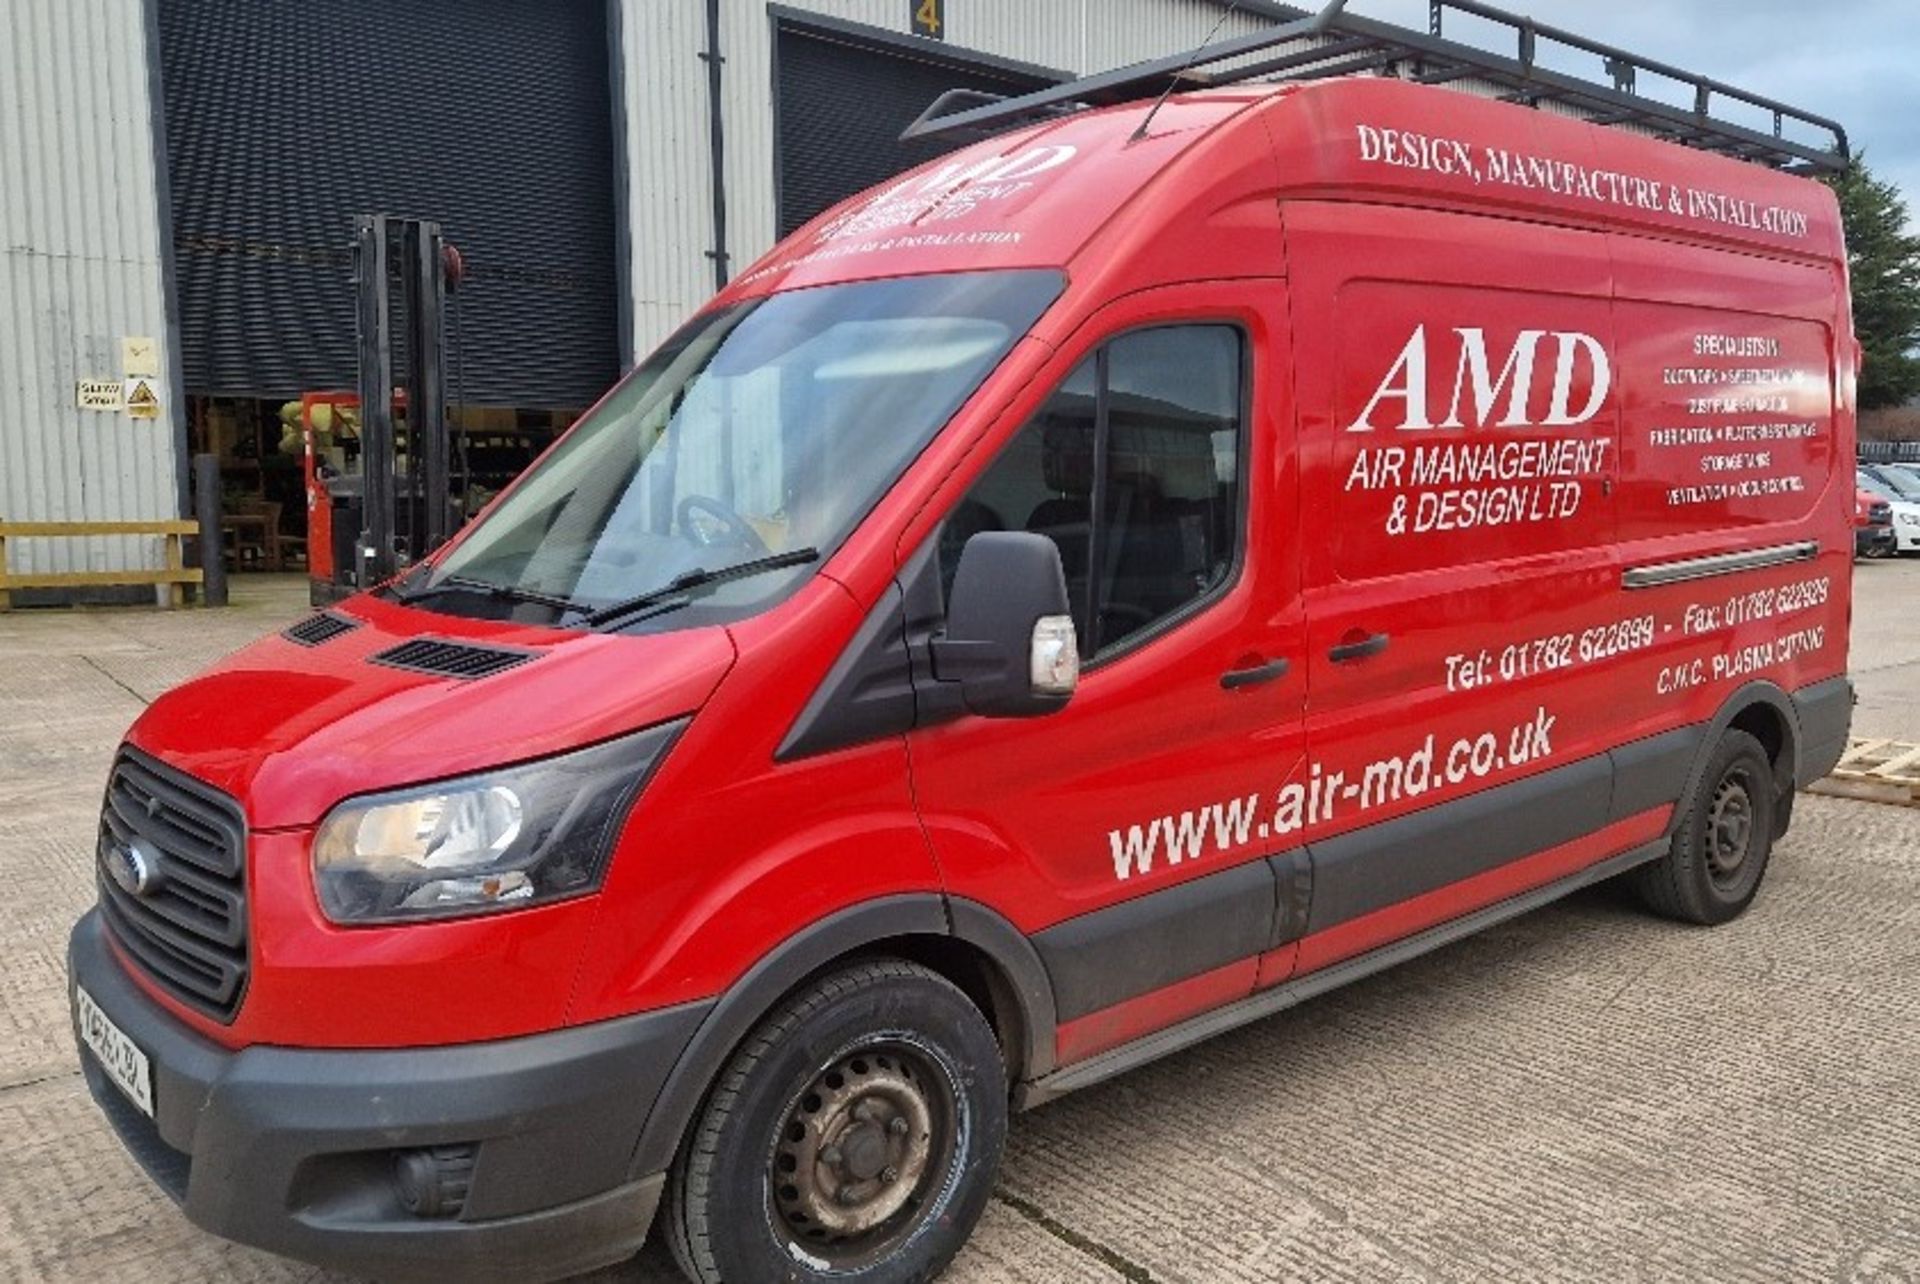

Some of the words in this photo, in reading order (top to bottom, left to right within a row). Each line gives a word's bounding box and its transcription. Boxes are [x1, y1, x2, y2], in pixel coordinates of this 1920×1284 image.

[917, 0, 940, 32] 4
[1356, 124, 1481, 185] DESIGN,
[1486, 147, 1663, 212] MANUFACTURE
[1668, 185, 1684, 216] &
[1688, 187, 1808, 238] INSTALLATION
[1345, 322, 1611, 432] AMD
[1345, 447, 1406, 491] AIR
[1410, 437, 1611, 487] MANAGEMENT
[1385, 494, 1407, 535] &
[1413, 484, 1529, 533] DESIGN
[1529, 481, 1582, 521] LTD
[1446, 651, 1493, 692] Tel:
[1499, 632, 1574, 681] 01782
[1579, 614, 1655, 663] 622899
[1684, 603, 1721, 635] Fax:
[1725, 587, 1776, 626] 01782
[1712, 642, 1774, 681] PLASMA
[1108, 706, 1556, 880] www.air-md.co.uk
